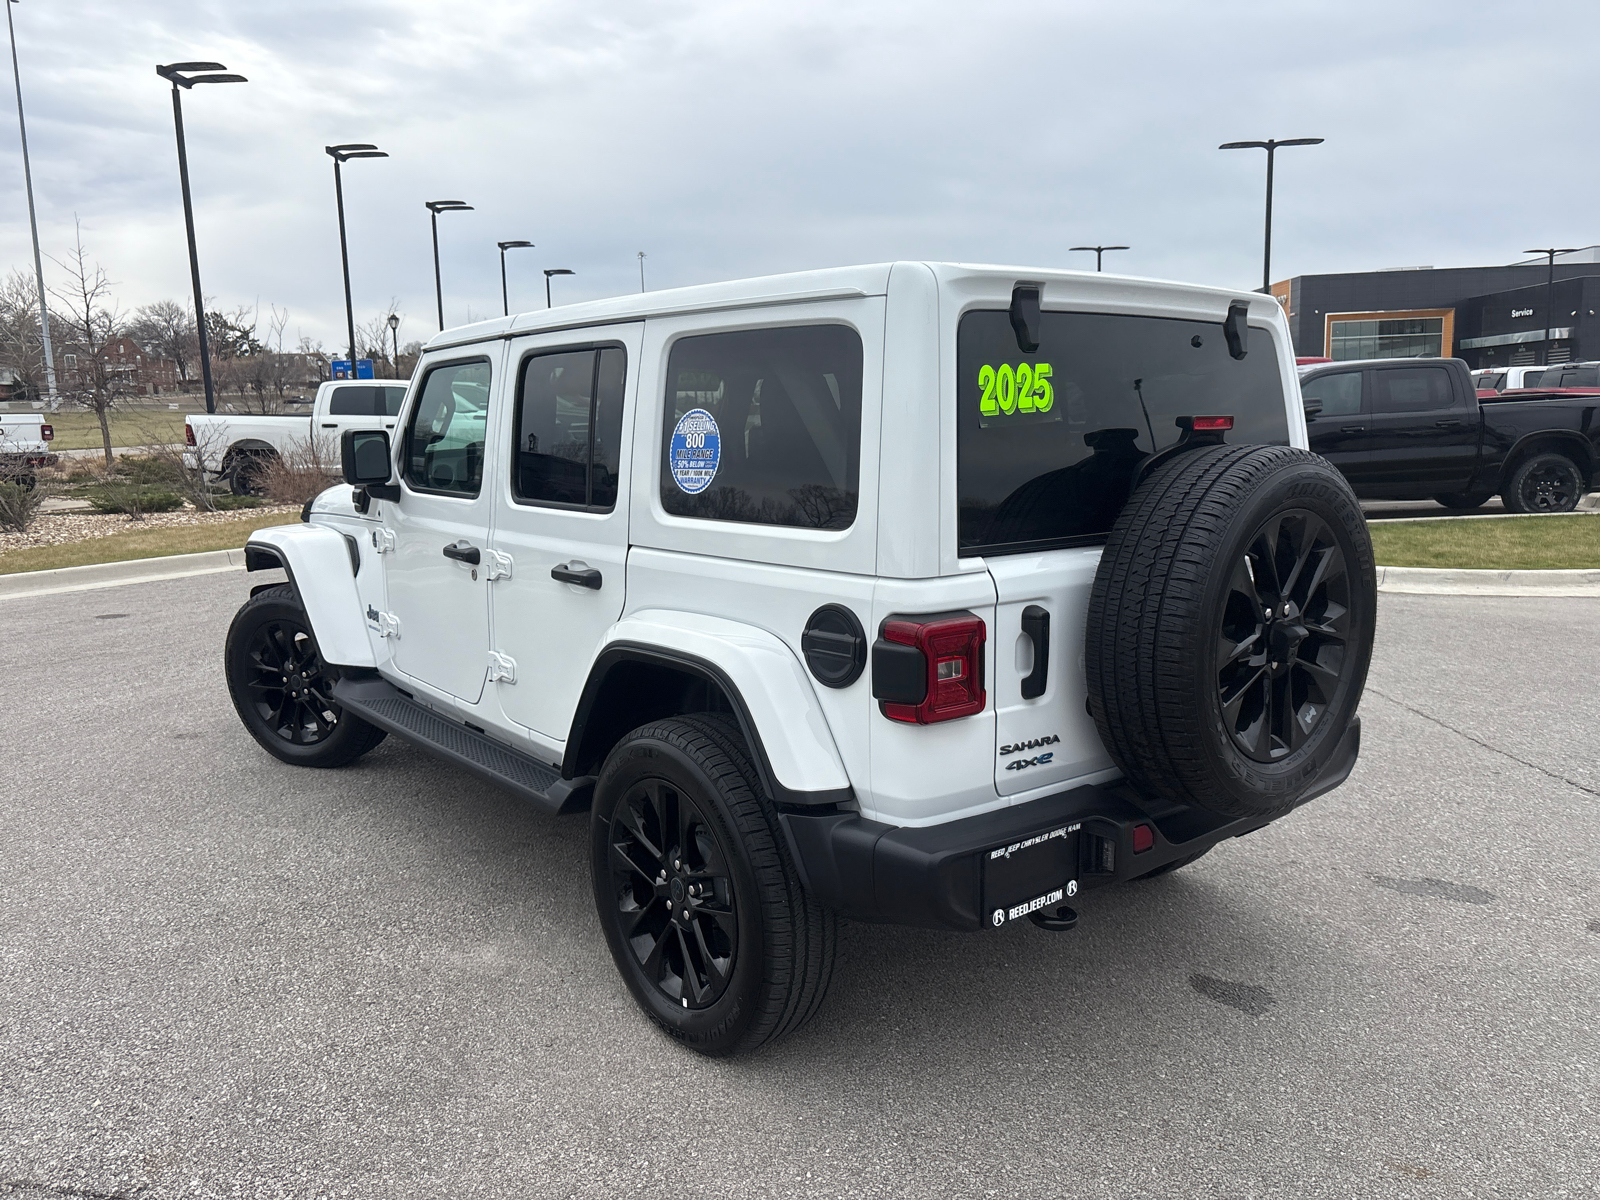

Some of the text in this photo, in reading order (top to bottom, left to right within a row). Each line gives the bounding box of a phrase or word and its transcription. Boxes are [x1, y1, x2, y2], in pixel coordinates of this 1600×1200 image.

[1511, 308, 1533, 318] Service
[978, 362, 1054, 416] 2025
[689, 420, 715, 431] SELLING
[686, 433, 705, 449] 800
[676, 449, 714, 459] MILE RANGE
[678, 460, 688, 468] 50%
[1284, 482, 1373, 588] BRIDGESTONE
[999, 734, 1061, 755] SAHARA
[991, 822, 1081, 859] REED JEEP CHRYSLER DODGE RAM
[1009, 889, 1063, 920] REEDJEEP.COM
